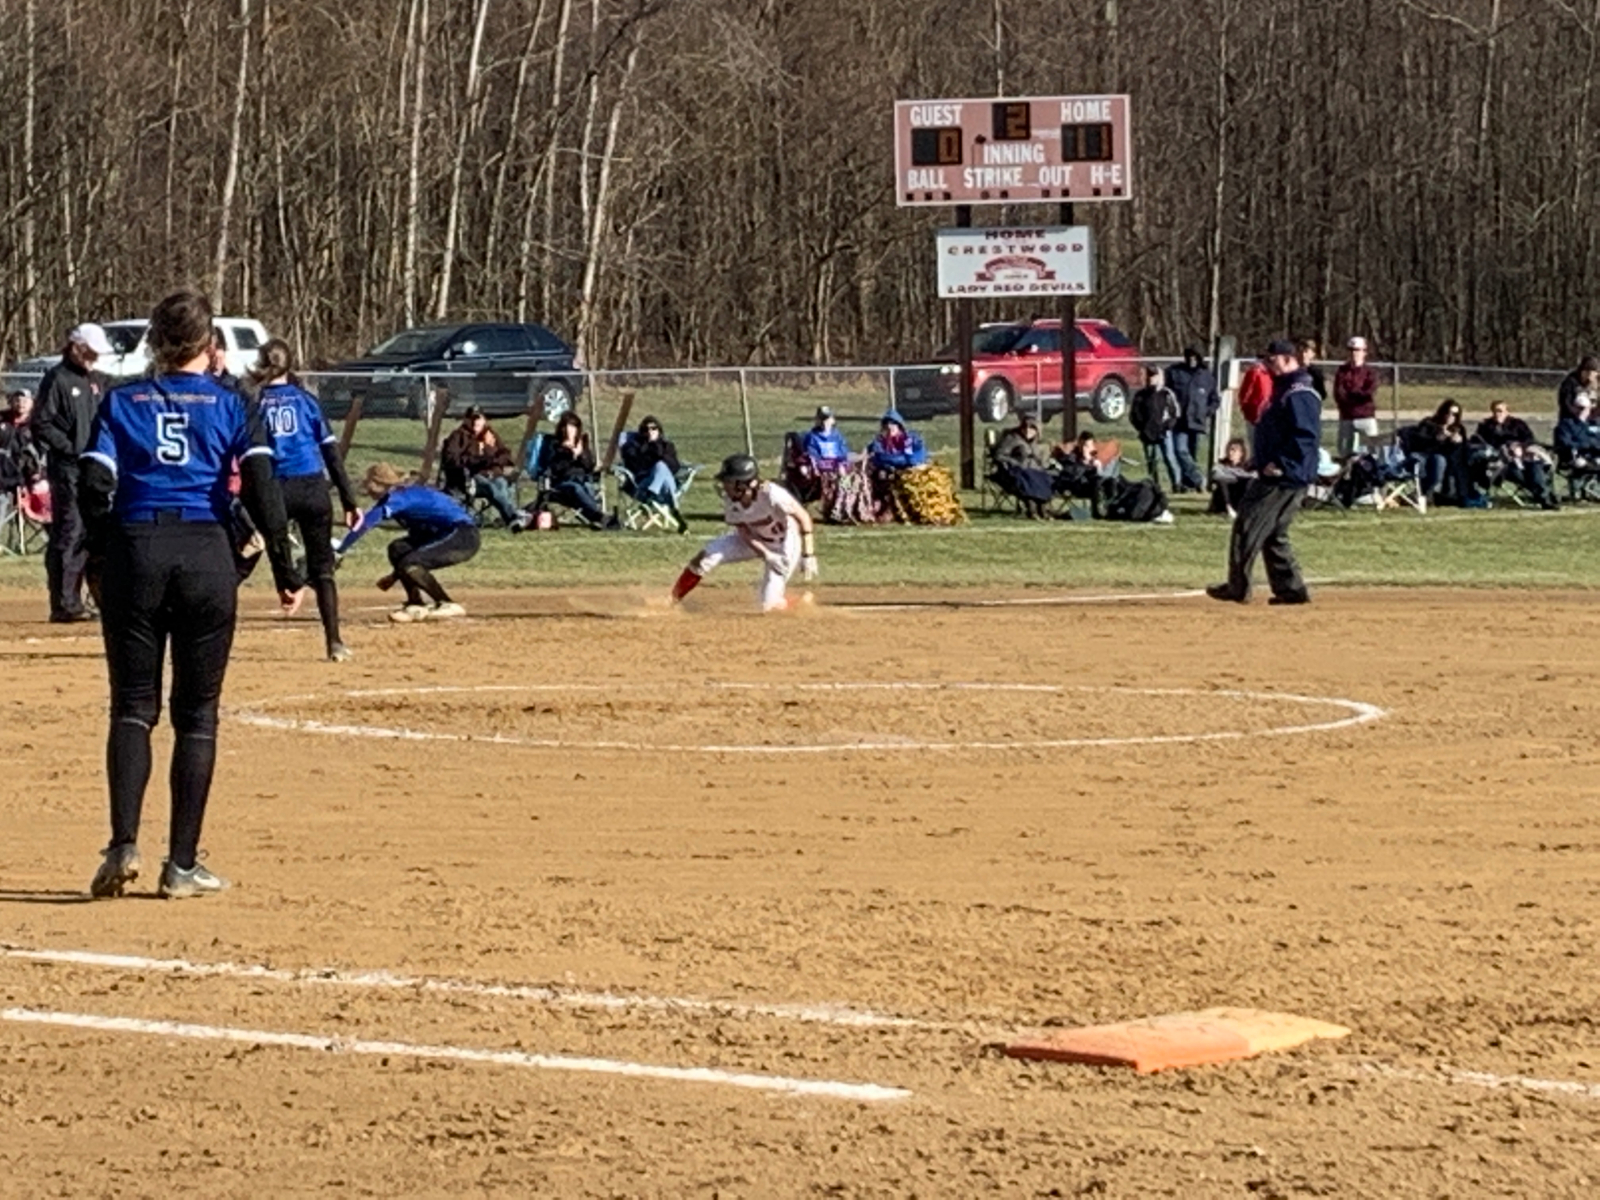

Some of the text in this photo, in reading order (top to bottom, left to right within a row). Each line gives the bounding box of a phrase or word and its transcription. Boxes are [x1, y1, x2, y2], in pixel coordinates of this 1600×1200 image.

[910, 104, 962, 126] GUEST
[1006, 104, 1027, 138] 2
[1061, 101, 1111, 122] HOME
[938, 129, 959, 163] 0
[983, 143, 1045, 165] INNING
[908, 168, 948, 189] BALL
[963, 167, 1023, 188] STRIKE
[1039, 166, 1073, 186] OUT
[985, 229, 1046, 240] HOME
[947, 243, 1084, 255] CRESTWOOD
[947, 282, 1086, 294] LADY RED DEVILS
[266, 406, 298, 437] 10
[156, 412, 190, 467] 5
